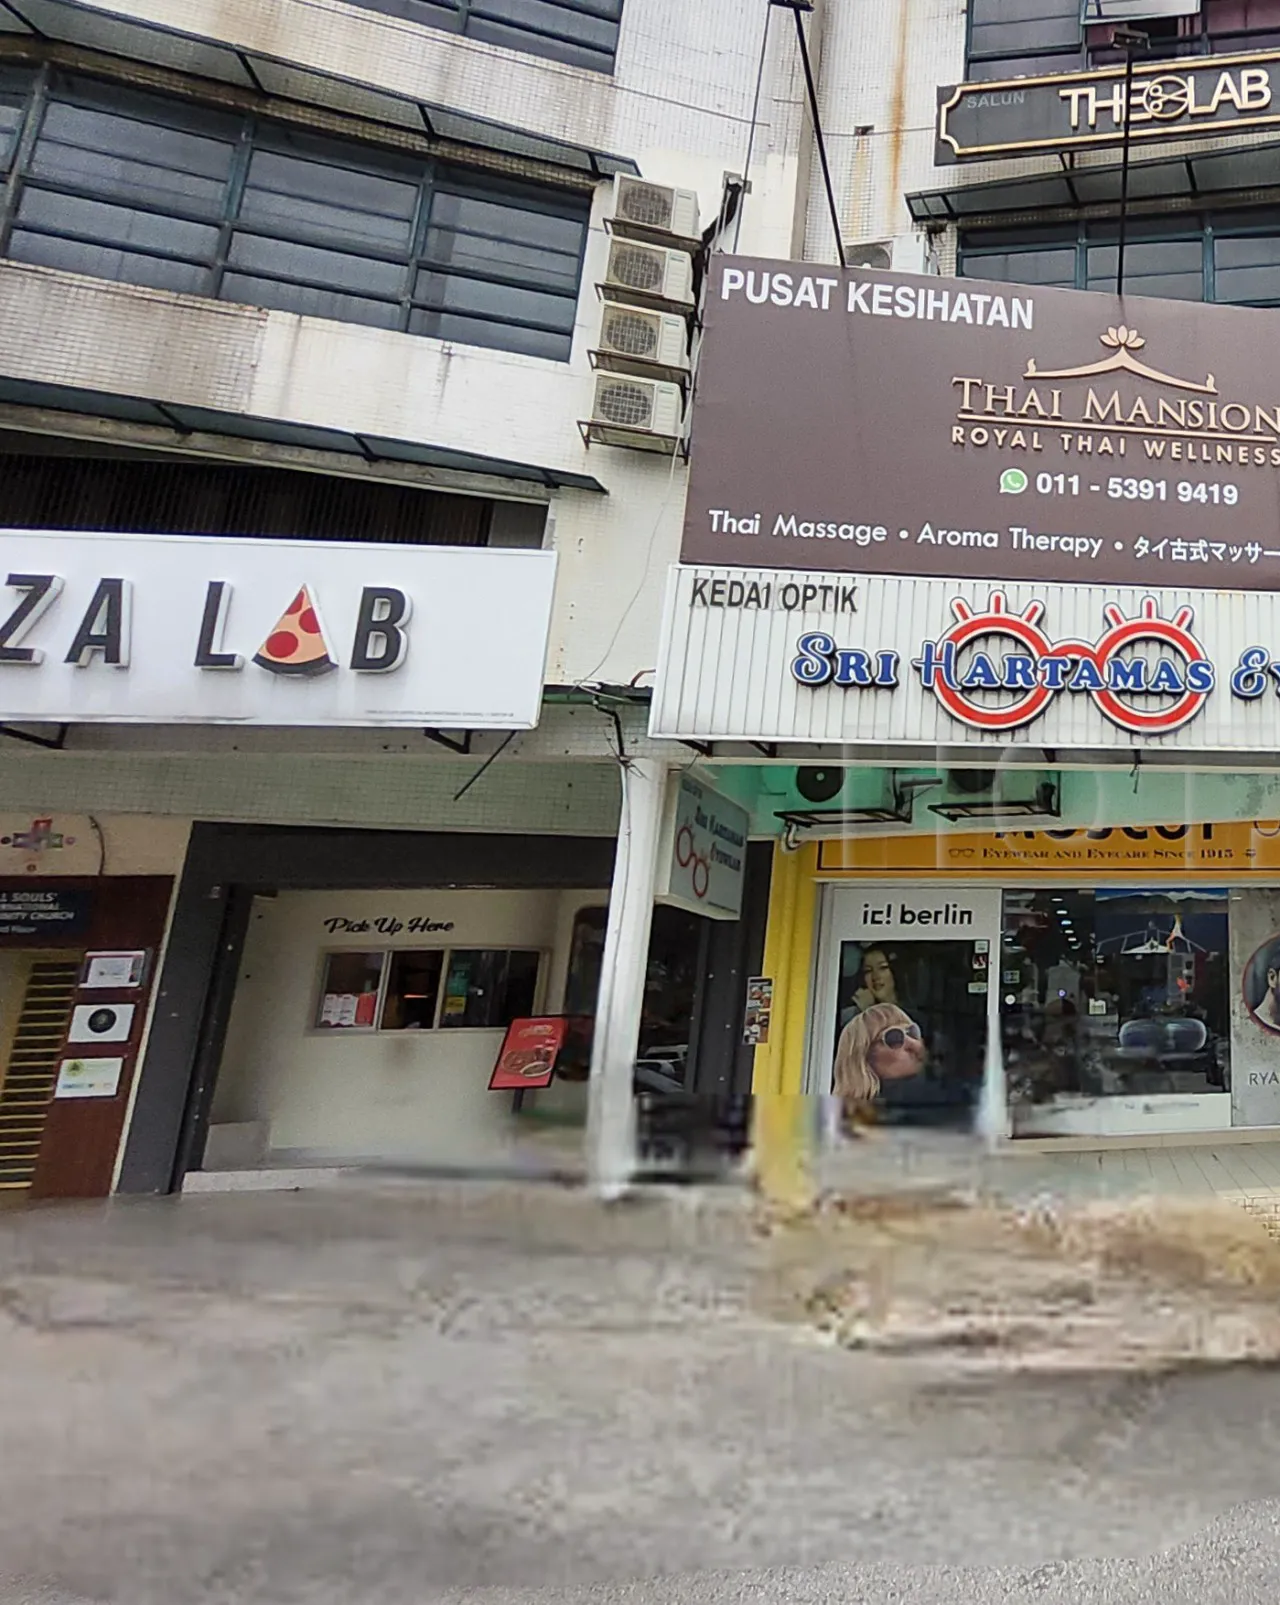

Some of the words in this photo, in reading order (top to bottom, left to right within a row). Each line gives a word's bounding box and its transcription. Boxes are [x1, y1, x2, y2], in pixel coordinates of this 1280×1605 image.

[1058, 80, 1152, 129] THE
[1187, 68, 1272, 117] LAB
[721, 268, 838, 310] PUSAT
[847, 281, 1034, 330] KESIHATAN
[951, 376, 1063, 419] THAI
[951, 426, 1043, 450] ROYAL
[1060, 433, 1126, 456] THAI
[1036, 473, 1080, 495] 011
[1107, 476, 1168, 501] 5391
[1177, 481, 1238, 506] 9419
[708, 509, 761, 535] Thai
[772, 513, 888, 546] Massage
[916, 522, 999, 548] Aroma
[1009, 527, 1103, 558] Therapy
[782, 583, 859, 613] OPTIK
[790, 631, 899, 688] SRI
[912, 638, 1217, 694] HARTAMAS
[982, 848, 1043, 859] EYEWEAR
[1045, 849, 1081, 859] AND
[1086, 848, 1149, 859] EYECARE
[1200, 848, 1234, 859] 1915
[323, 917, 371, 934] Pick
[374, 916, 404, 936] Up
[408, 917, 455, 933] Here
[900, 903, 973, 925] berlin
